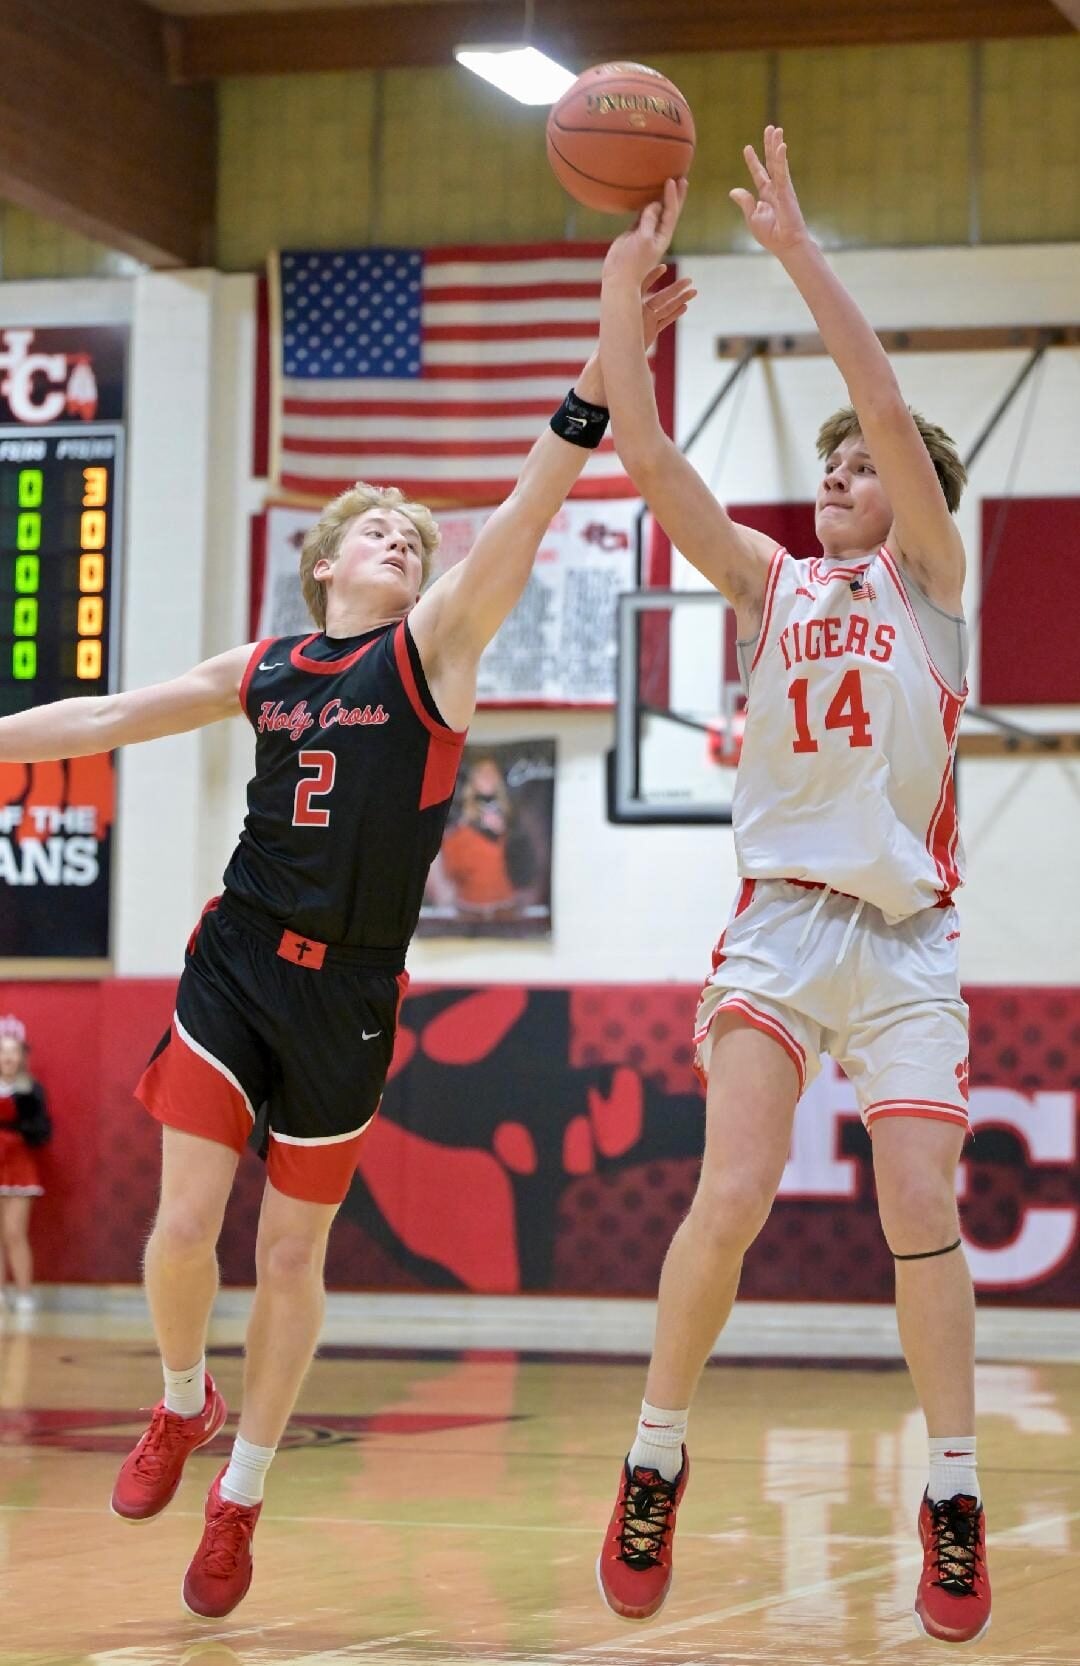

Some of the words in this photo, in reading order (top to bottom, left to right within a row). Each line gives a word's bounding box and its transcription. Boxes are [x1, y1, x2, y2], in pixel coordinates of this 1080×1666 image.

[18, 469, 43, 507] 0
[82, 467, 107, 507] 3
[17, 512, 41, 550] 0
[81, 510, 106, 549] 0
[15, 555, 40, 593] 0
[79, 554, 104, 592] 0
[13, 598, 38, 636] 0
[78, 597, 103, 636] 0
[13, 641, 37, 679] 0
[77, 640, 102, 679] 0
[779, 614, 896, 670] TIGERS
[258, 701, 314, 741] Holy
[319, 699, 389, 729] Cross
[788, 669, 872, 753] 14
[292, 750, 336, 827] 2
[29, 805, 96, 834] THE
